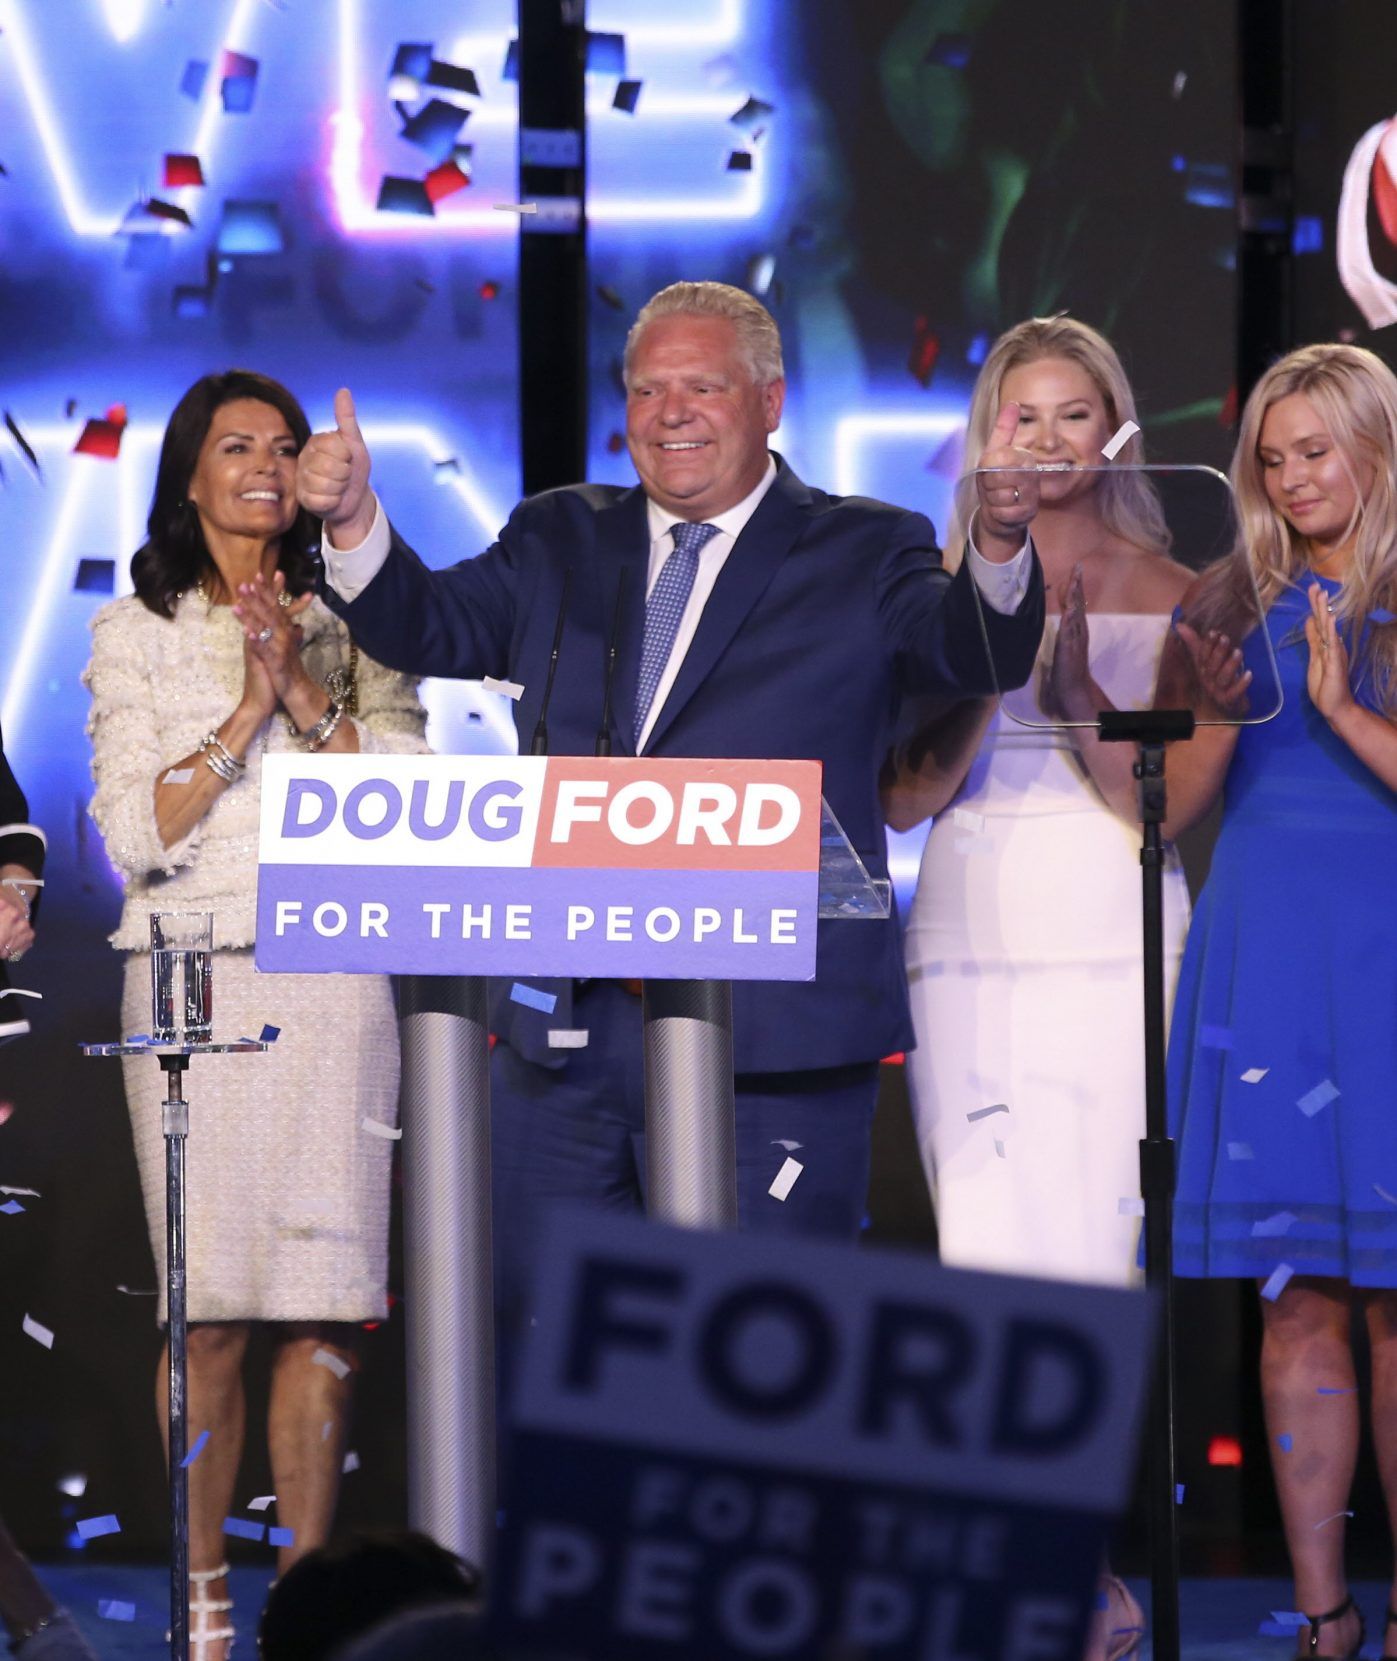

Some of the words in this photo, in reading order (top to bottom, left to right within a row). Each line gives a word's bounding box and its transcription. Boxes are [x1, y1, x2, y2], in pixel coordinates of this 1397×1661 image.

[280, 778, 525, 842] DOUG
[550, 780, 802, 846] FORD
[274, 901, 390, 939] FOR
[423, 904, 533, 940] THE
[567, 906, 799, 944] PEOPLE
[559, 1254, 1111, 1458] FORD
[632, 1465, 821, 1551] FOR
[516, 1522, 1084, 1661] PEOPLE
